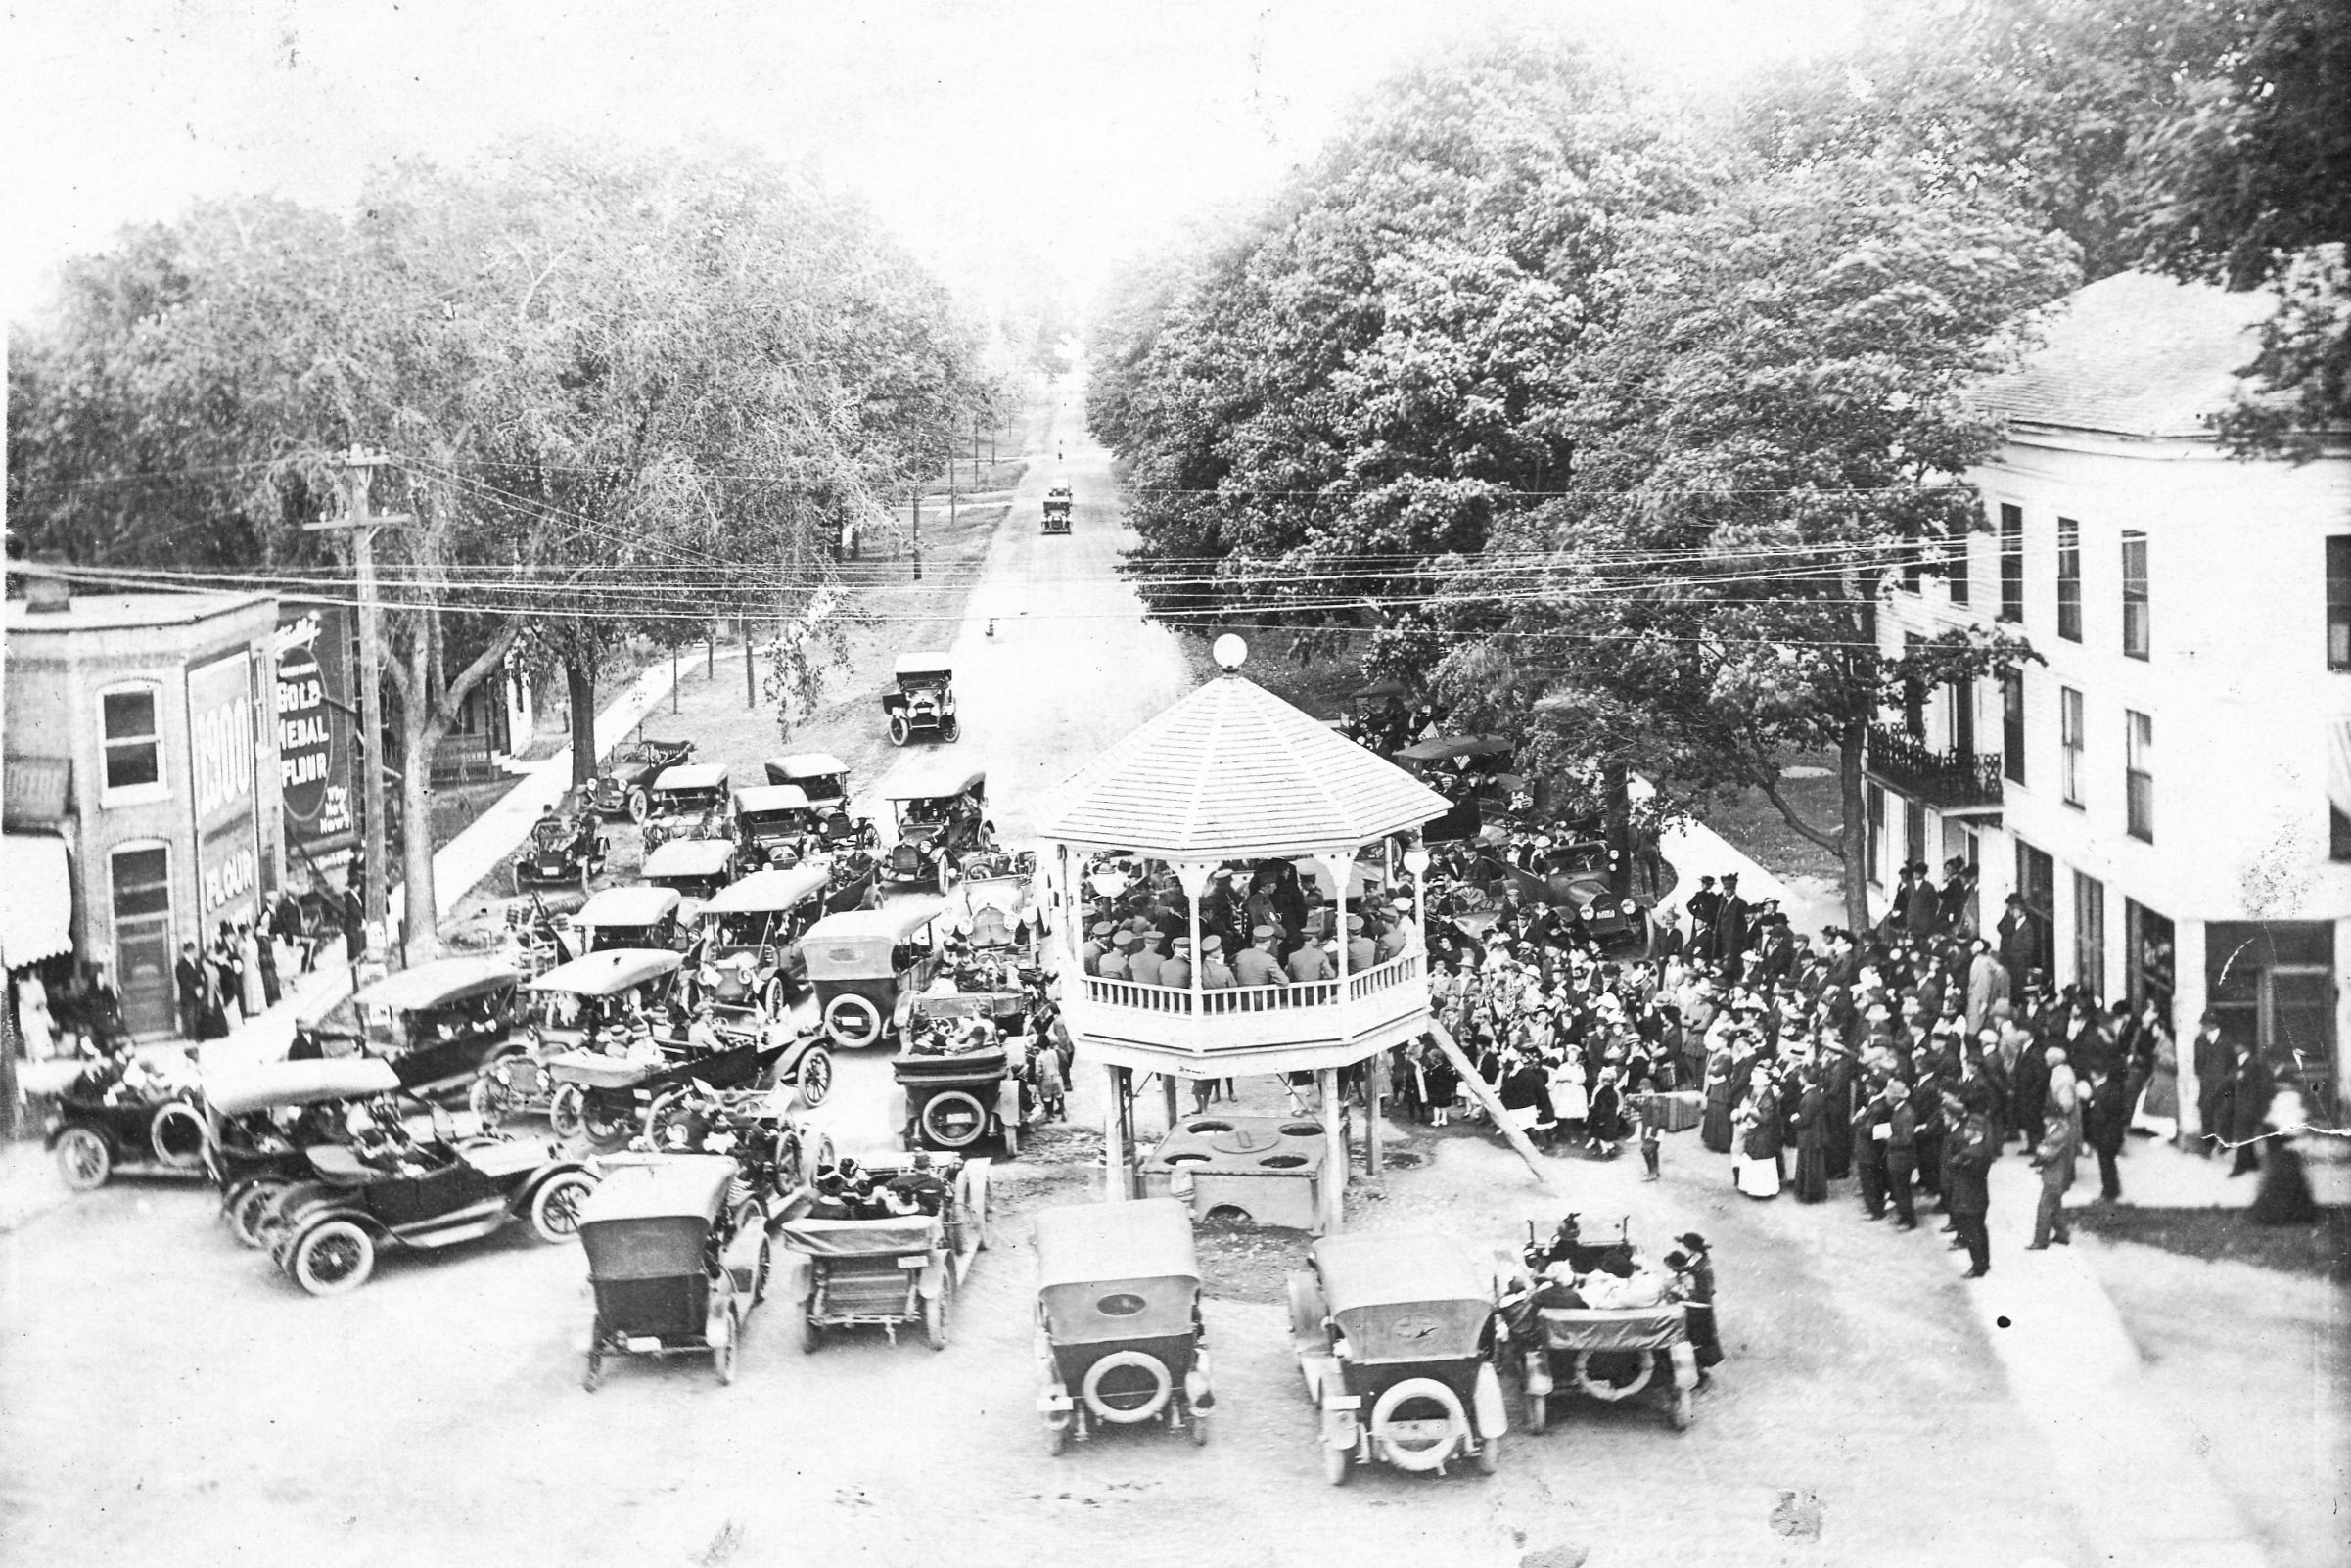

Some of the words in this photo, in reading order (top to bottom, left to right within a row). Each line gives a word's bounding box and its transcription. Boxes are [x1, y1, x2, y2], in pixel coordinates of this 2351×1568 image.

[276, 679, 321, 713] GOLD
[197, 696, 250, 818] 1900
[281, 752, 327, 788] FLOUR
[205, 848, 253, 913] FLOUR
